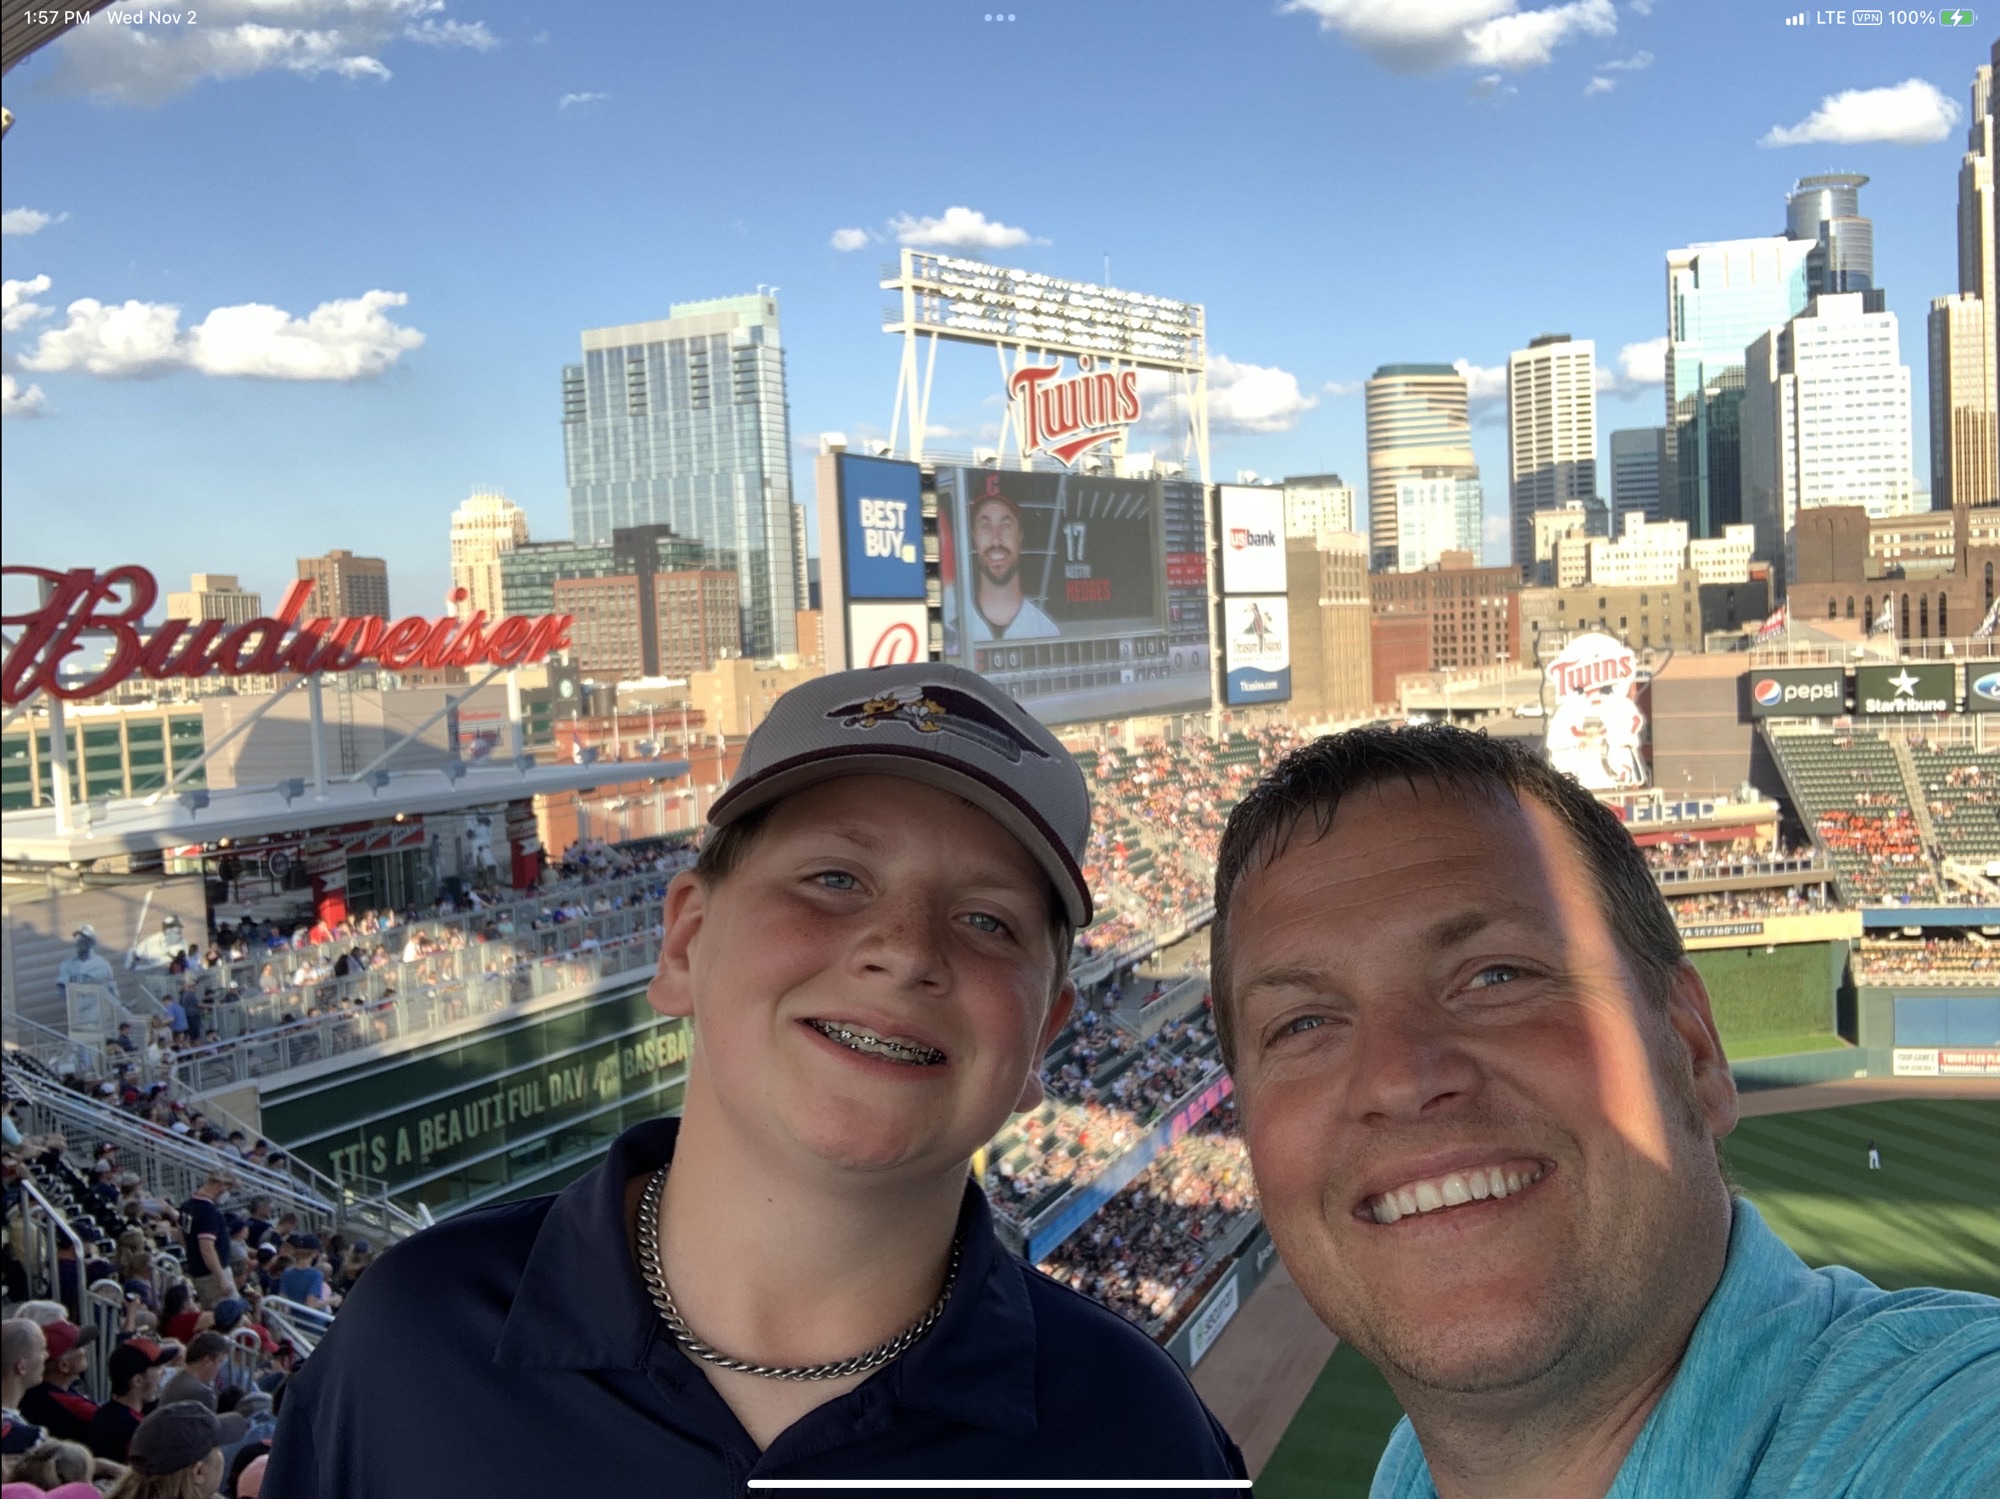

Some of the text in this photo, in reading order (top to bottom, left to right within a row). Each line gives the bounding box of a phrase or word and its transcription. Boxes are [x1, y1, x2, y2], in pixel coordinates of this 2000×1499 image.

[1009, 354, 1142, 457] Twins
[859, 498, 907, 530] BEST
[1062, 522, 1086, 562] 17
[1, 565, 574, 703] Budweiser
[1550, 655, 1632, 697] Twins
[1784, 680, 1839, 703] pepsi
[1633, 800, 1716, 823] FIELD
[328, 1134, 388, 1183] IT'S
[395, 1127, 412, 1166] A
[419, 1081, 546, 1157] BEAUTIFUL
[549, 1064, 585, 1108] DAY
